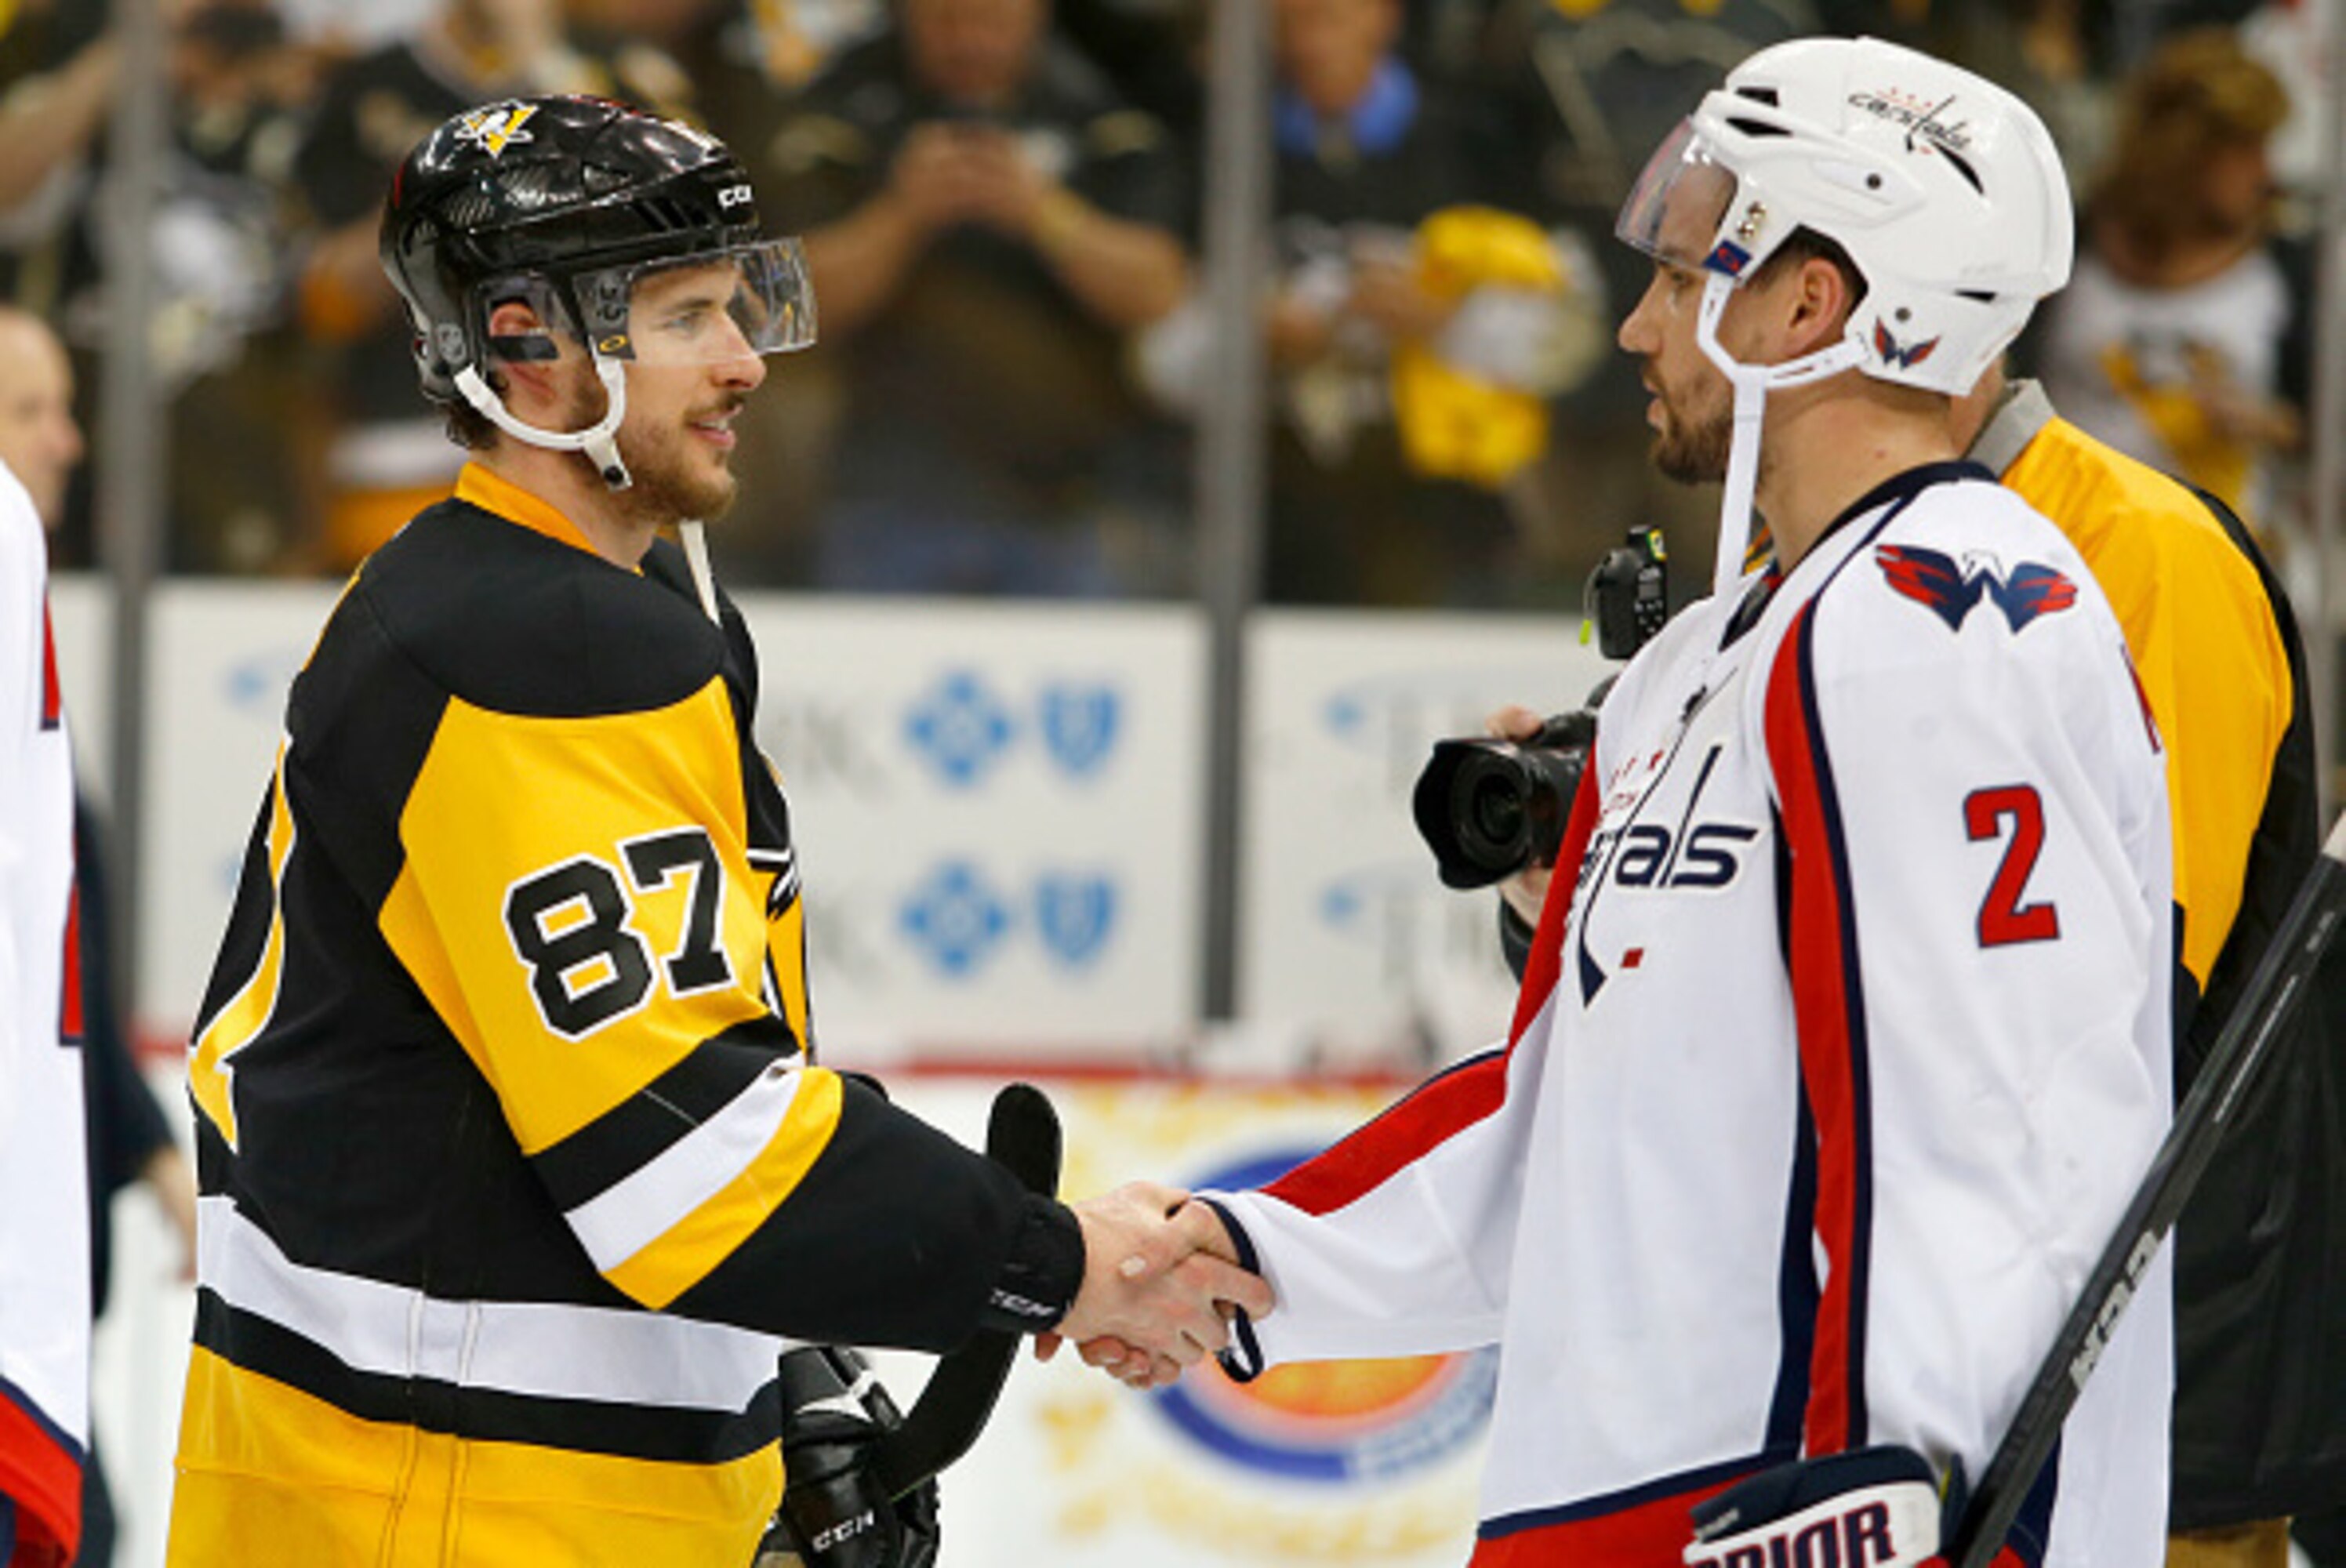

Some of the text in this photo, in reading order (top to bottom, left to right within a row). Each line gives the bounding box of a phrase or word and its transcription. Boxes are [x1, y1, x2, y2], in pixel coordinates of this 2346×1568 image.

[501, 824, 739, 1044] 87
[1962, 782, 2061, 949] 2
[2068, 1229, 2160, 1392] CCM
[812, 1509, 874, 1552] CCM
